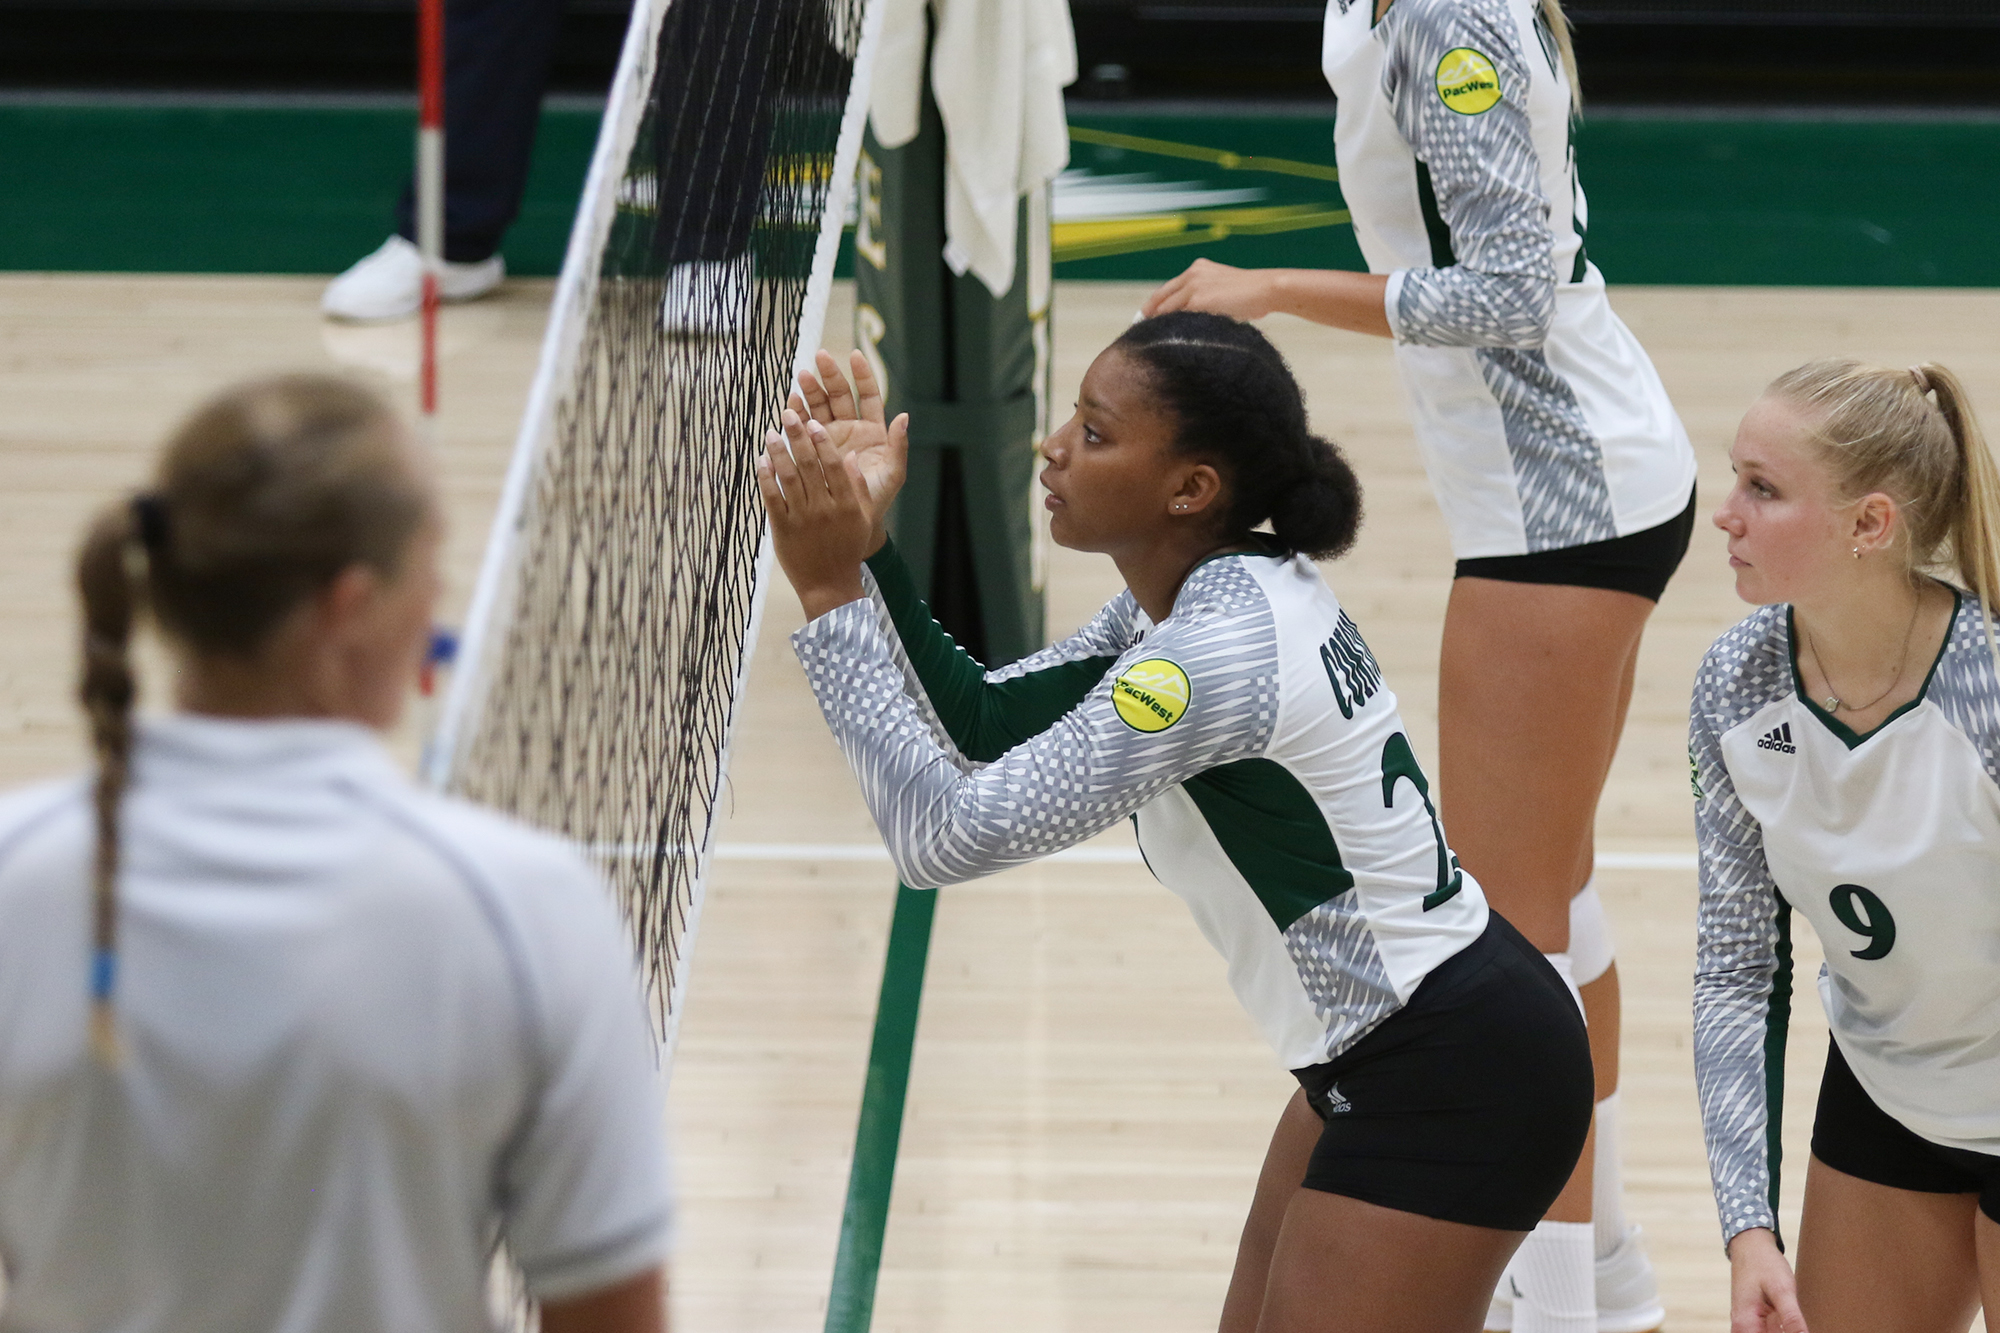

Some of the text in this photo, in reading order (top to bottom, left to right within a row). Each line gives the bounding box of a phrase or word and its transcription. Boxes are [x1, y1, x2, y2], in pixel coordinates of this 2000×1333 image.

[1443, 80, 1494, 98] PacWes
[1116, 681, 1174, 723] PacWest
[1757, 738, 1796, 754] adidas
[1829, 883, 1896, 960] 9
